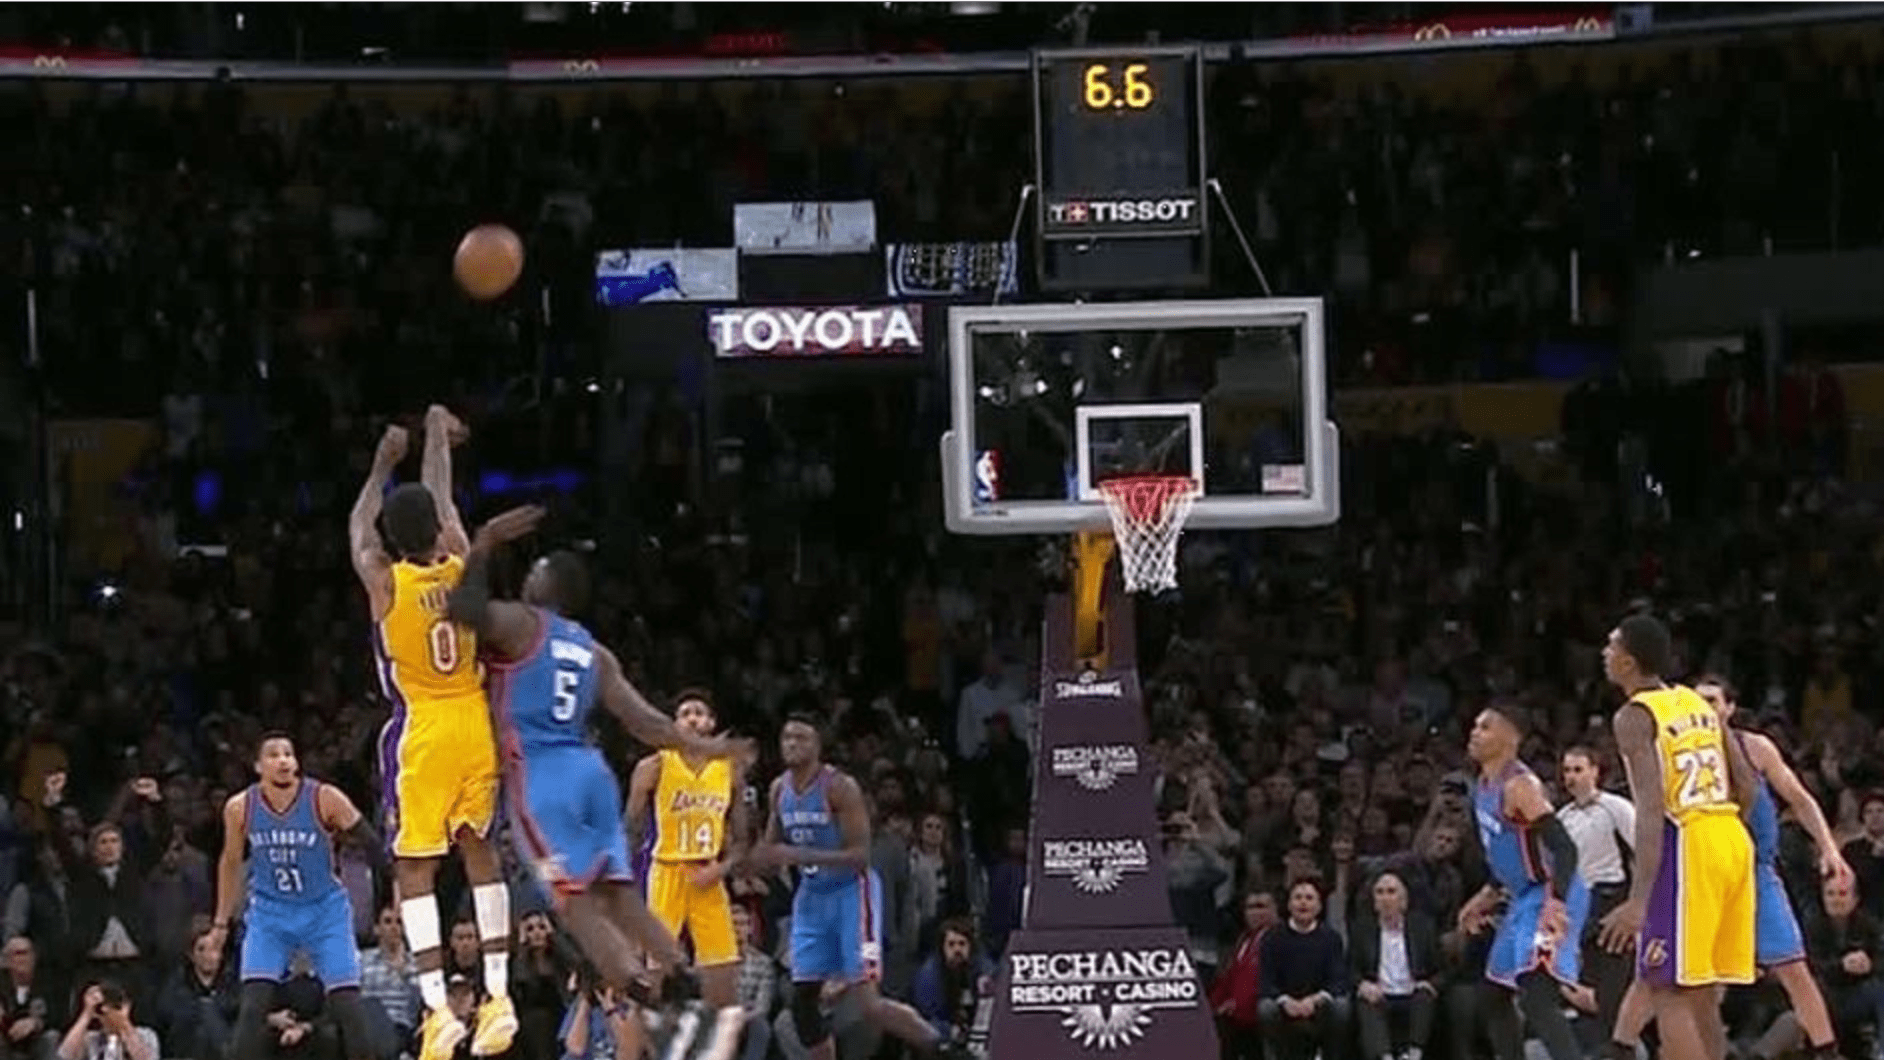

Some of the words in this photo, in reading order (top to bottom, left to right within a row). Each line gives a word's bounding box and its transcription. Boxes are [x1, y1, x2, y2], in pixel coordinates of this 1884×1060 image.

[1085, 64, 1152, 108] 6.6
[1089, 200, 1196, 222] TISSOT
[712, 310, 922, 352] TOYOTA
[431, 621, 457, 671] 0
[553, 670, 579, 720] 5
[1675, 748, 1728, 805] 23
[679, 819, 713, 852] 14
[1043, 840, 1148, 857] PECHANGA
[275, 868, 303, 893] 21
[1011, 949, 1197, 980] PECHANGA
[1011, 984, 1096, 1004] RESORT
[1115, 980, 1197, 1000] CASINO
